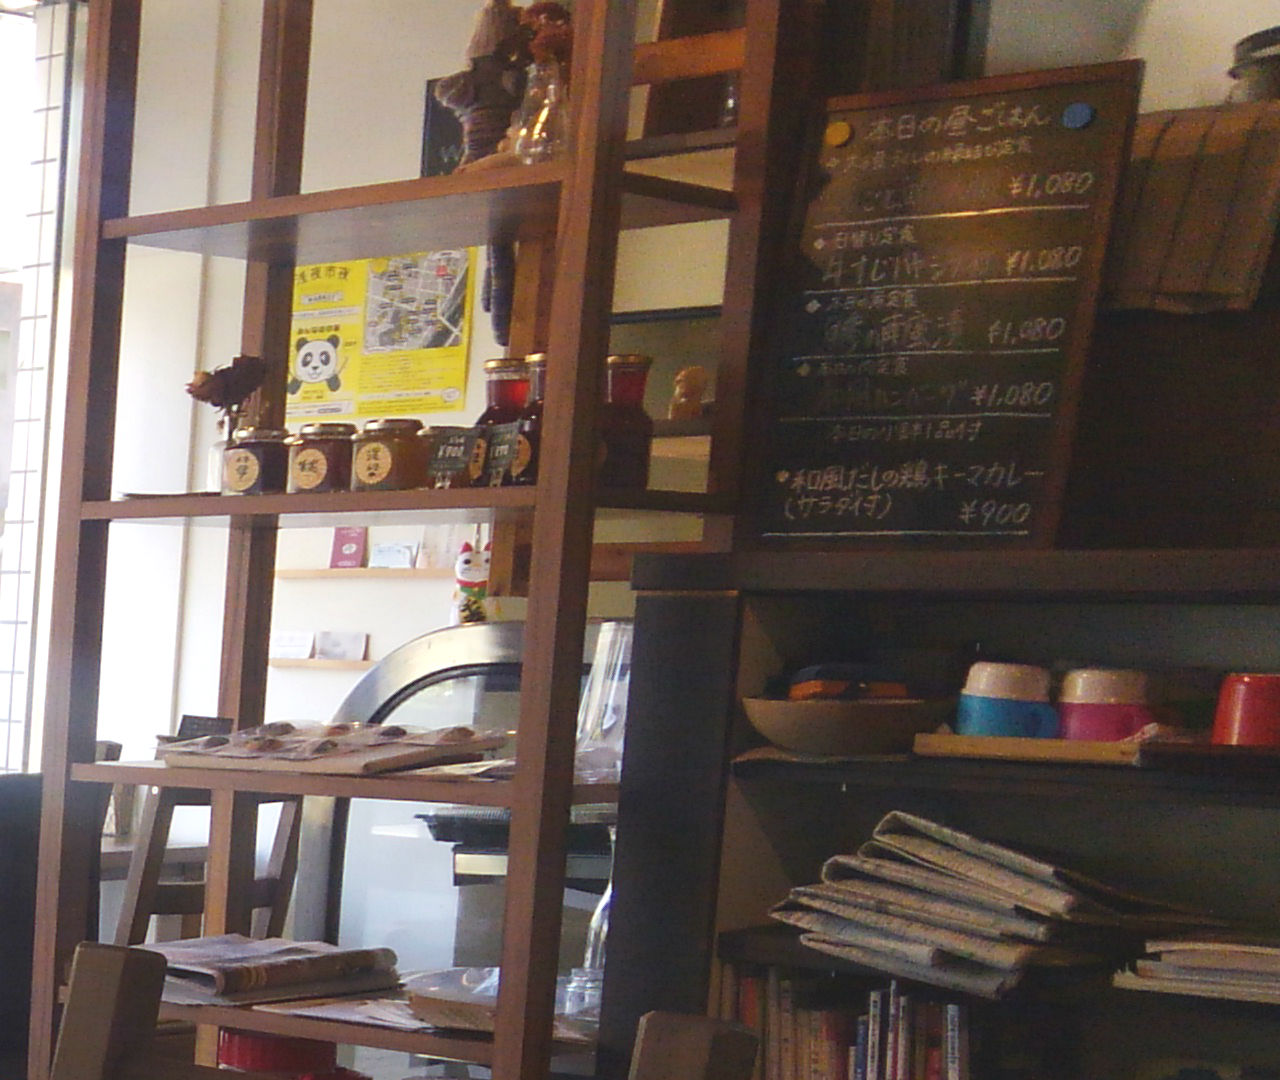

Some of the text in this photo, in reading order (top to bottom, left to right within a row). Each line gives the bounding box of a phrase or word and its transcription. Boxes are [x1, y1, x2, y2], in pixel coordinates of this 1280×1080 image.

[867, 103, 1050, 140] 本日の昼ごはん
[959, 500, 1032, 527] ¥900
